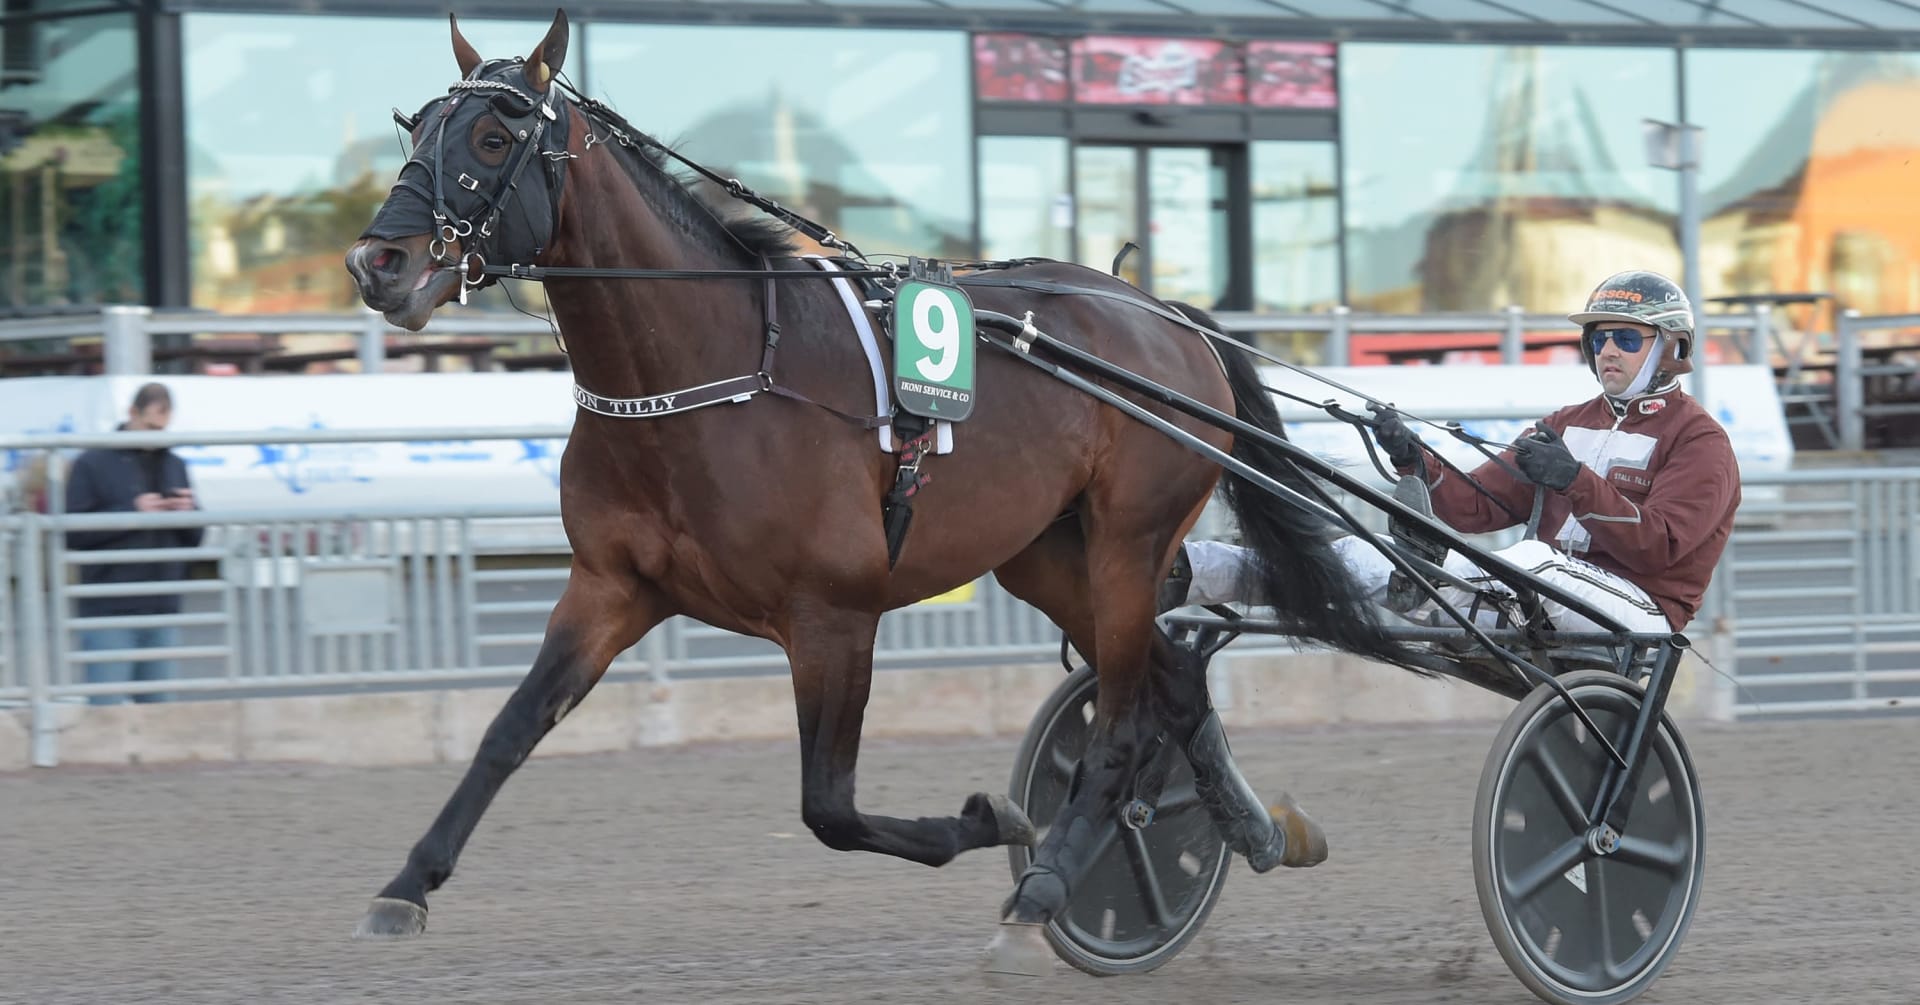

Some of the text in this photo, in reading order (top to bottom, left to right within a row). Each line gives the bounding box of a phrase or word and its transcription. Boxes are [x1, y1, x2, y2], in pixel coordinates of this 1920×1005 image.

[912, 288, 960, 382] 9
[901, 381, 969, 402] IKONI SERVICE & CO
[609, 396, 677, 414] TILLY
[1614, 472, 1632, 482] STALL
